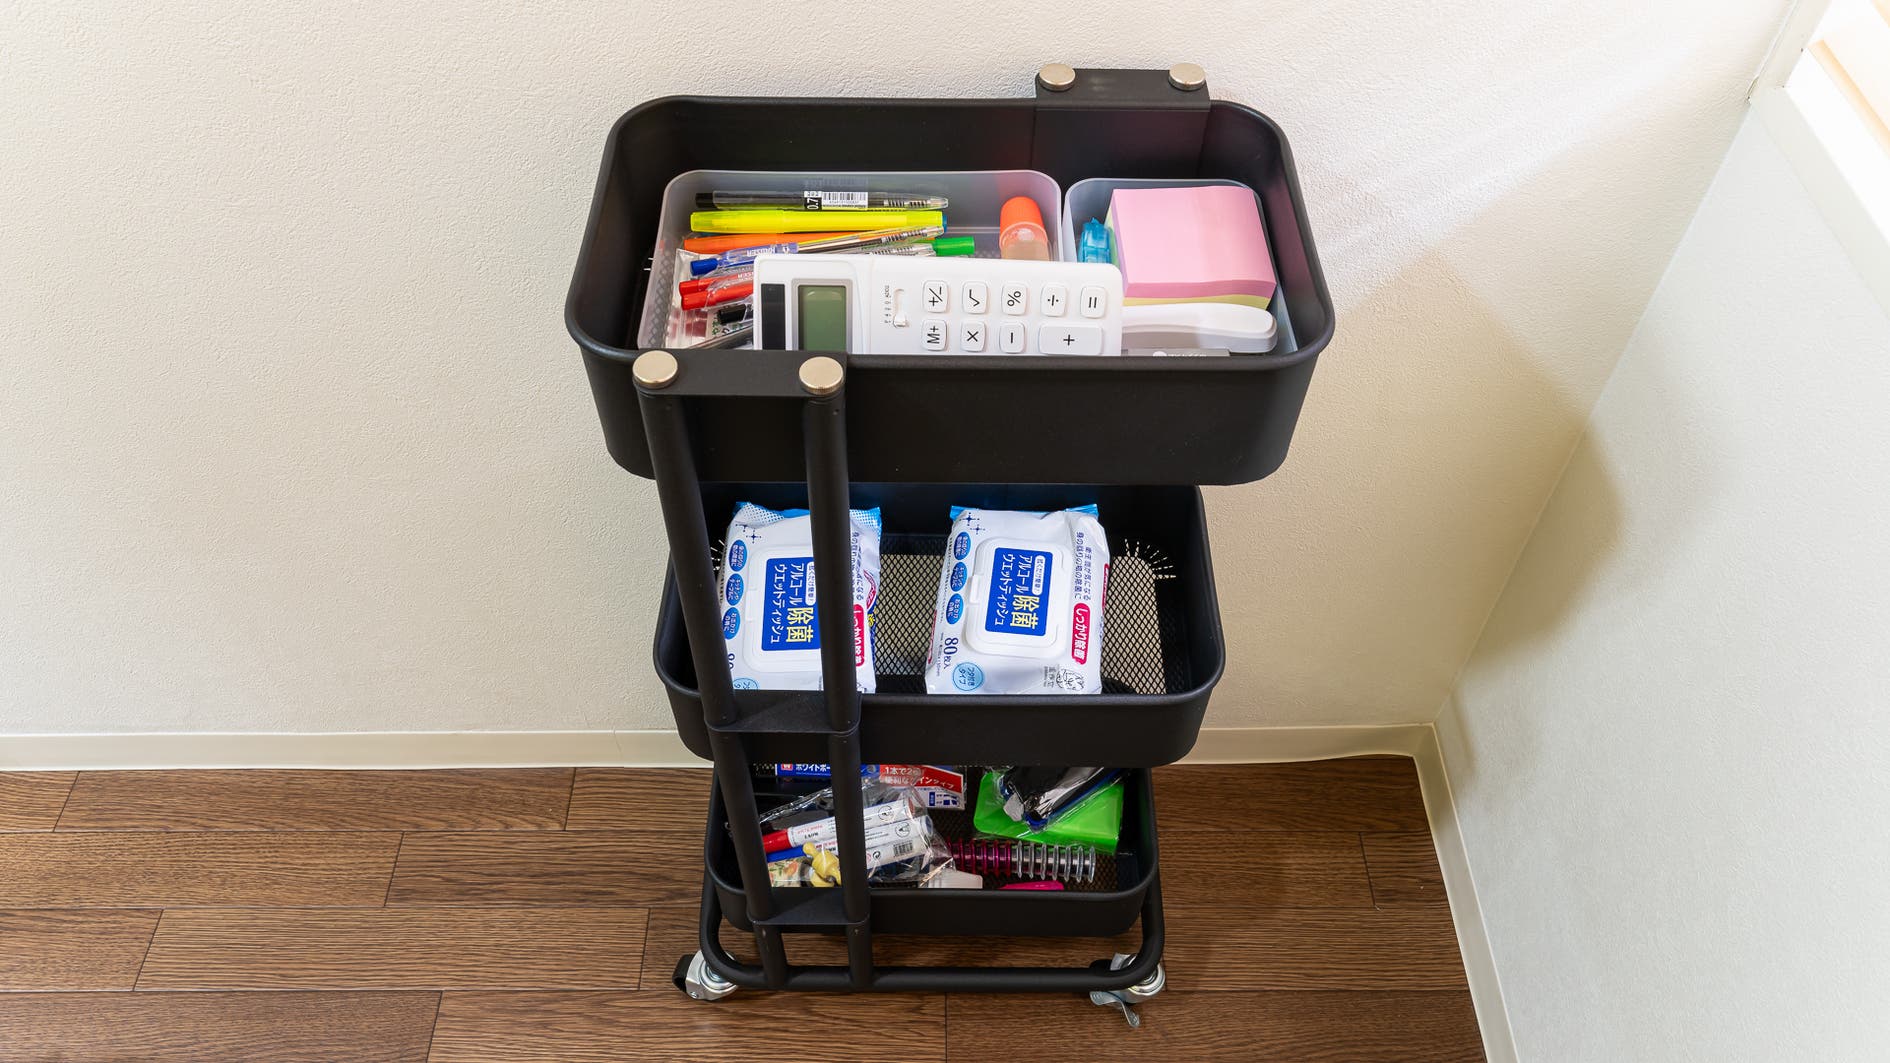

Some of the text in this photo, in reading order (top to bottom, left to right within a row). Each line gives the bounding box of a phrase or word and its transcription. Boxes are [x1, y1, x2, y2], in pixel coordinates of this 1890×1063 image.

[807, 198, 819, 210] 0.7
[927, 325, 940, 344] M+
[1073, 607, 1088, 660] しっかり除菌
[943, 637, 959, 669] 80枚入
